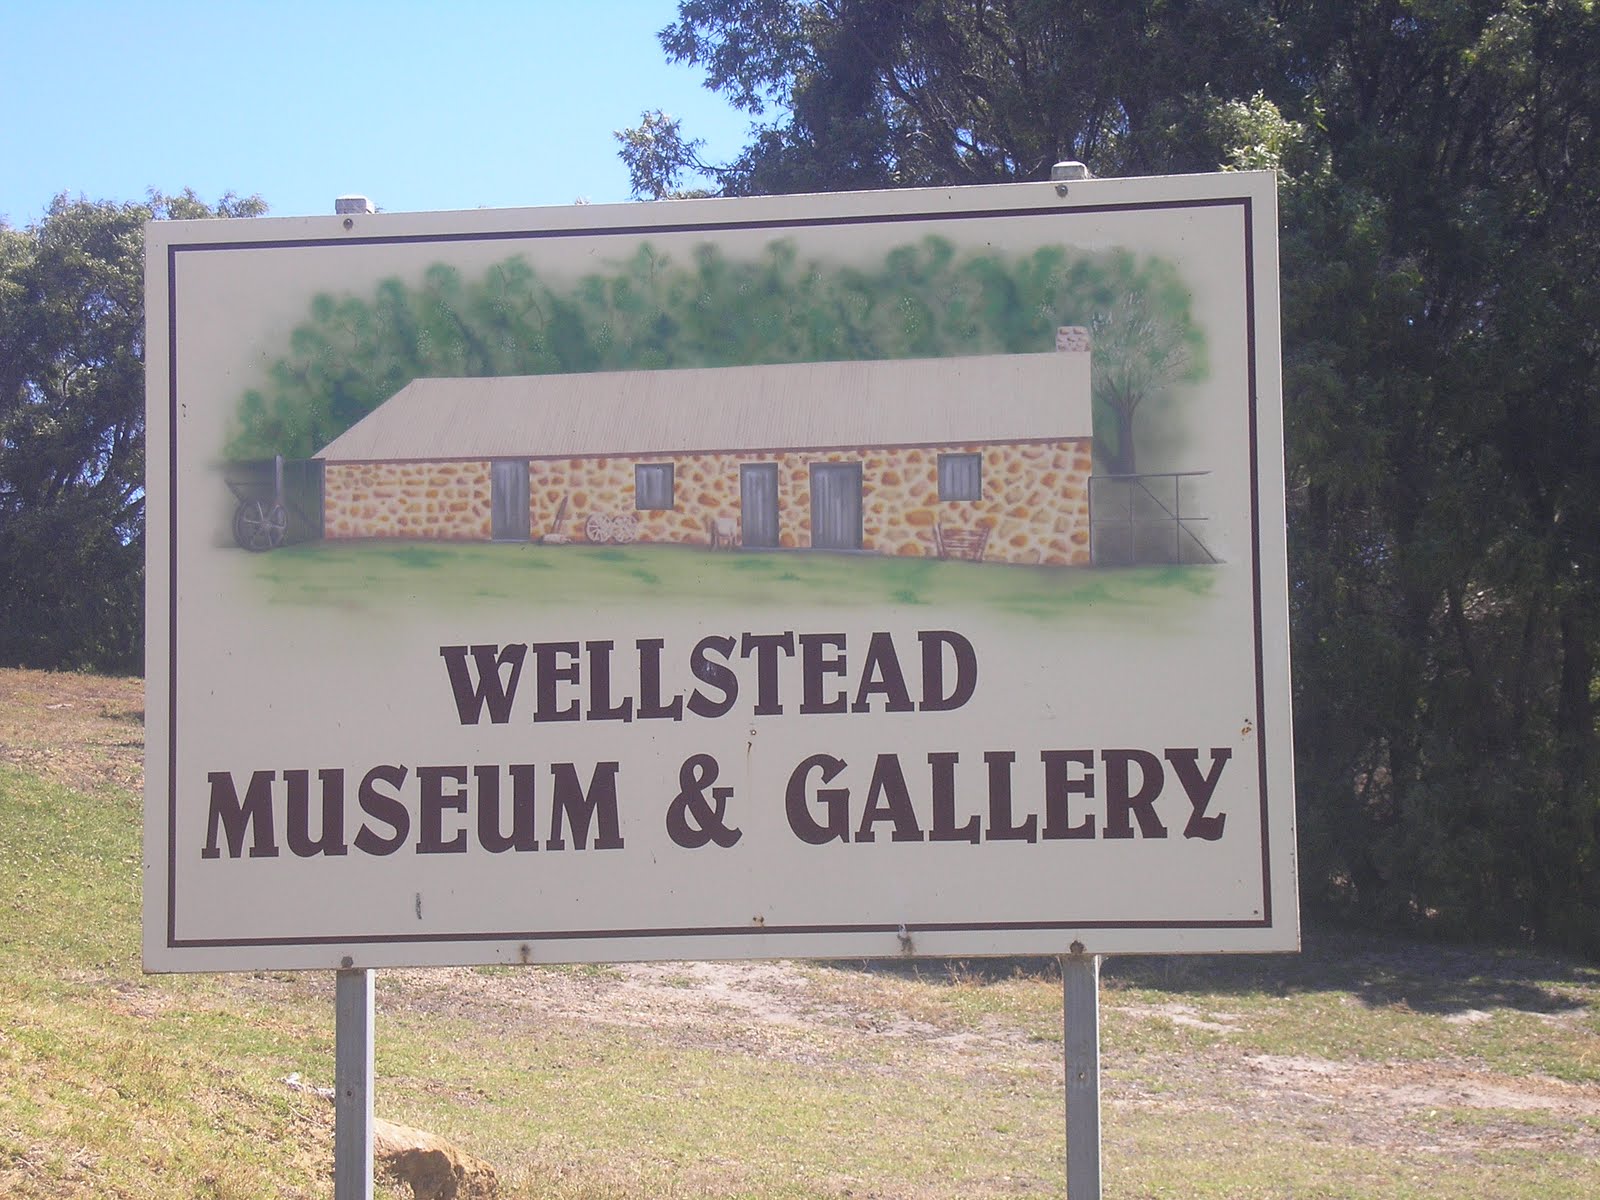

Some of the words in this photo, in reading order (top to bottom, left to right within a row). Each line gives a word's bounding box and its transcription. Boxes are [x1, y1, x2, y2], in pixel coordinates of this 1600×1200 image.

[440, 631, 977, 725] WELLSTEAD
[202, 762, 624, 859] MUSEUM
[666, 754, 742, 848] &
[785, 748, 1232, 845] GALLERY
